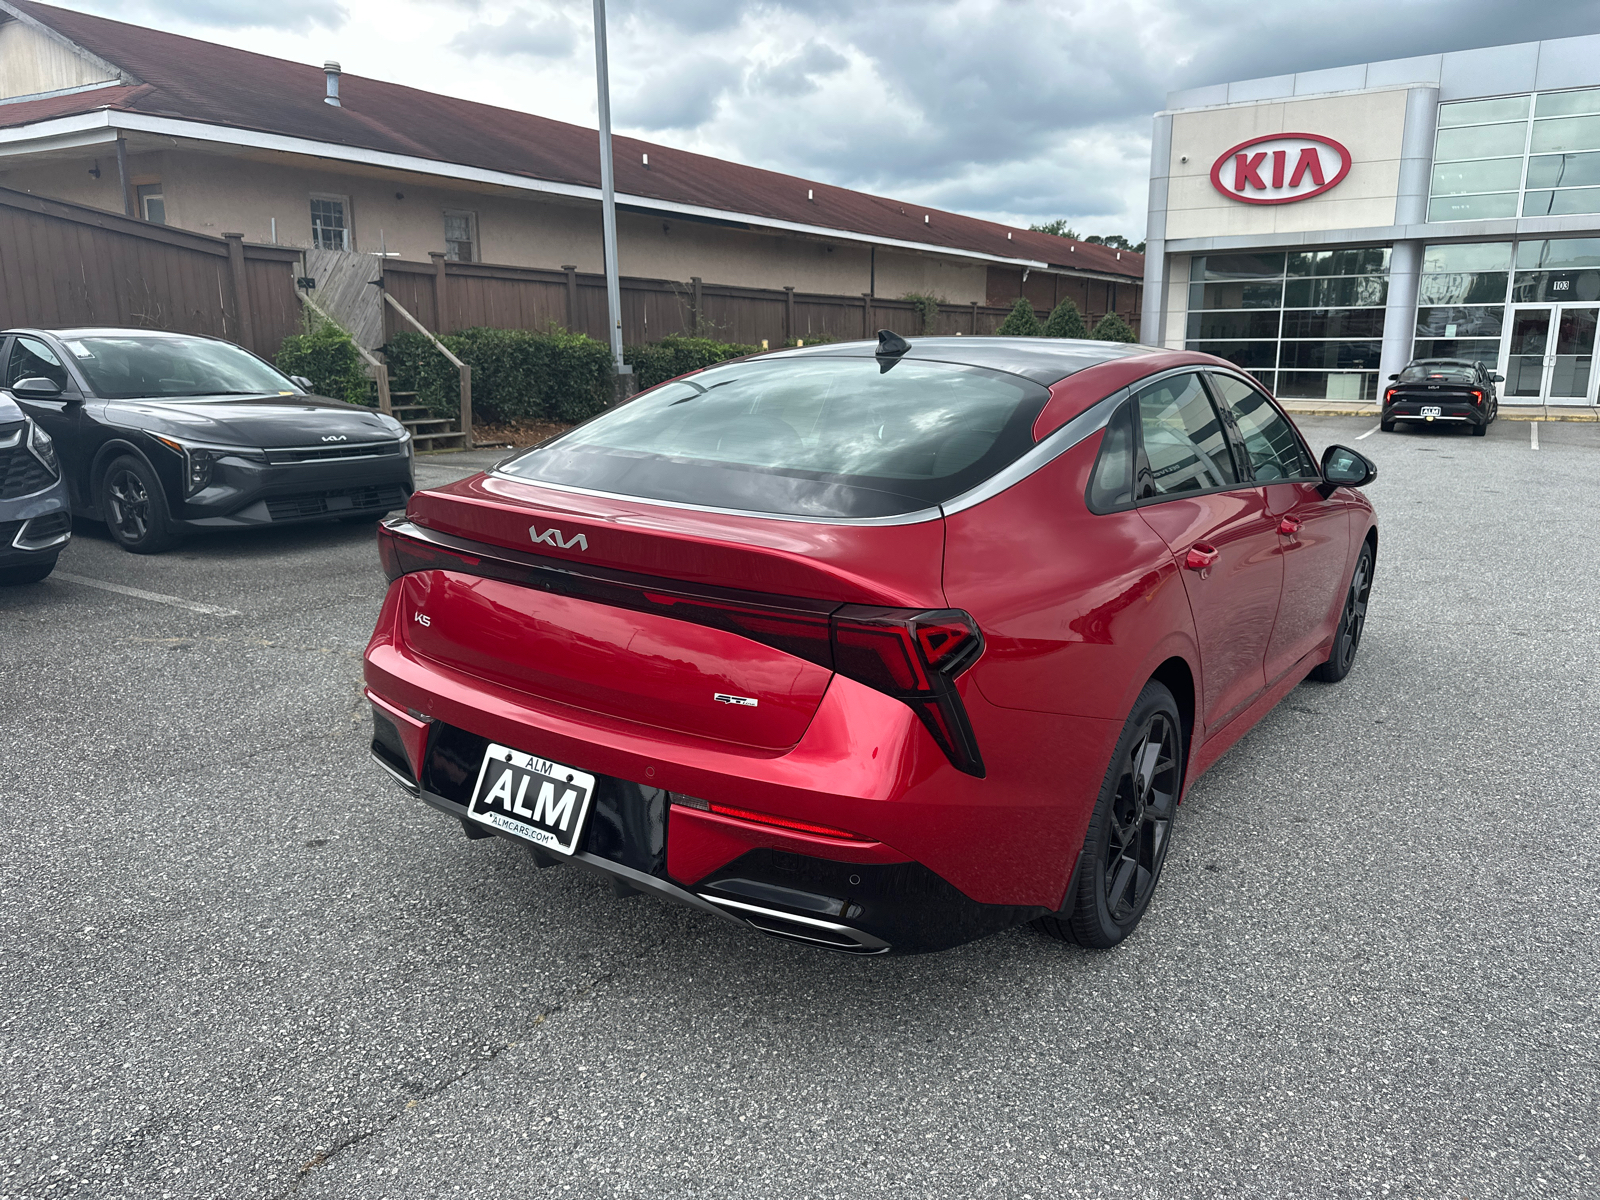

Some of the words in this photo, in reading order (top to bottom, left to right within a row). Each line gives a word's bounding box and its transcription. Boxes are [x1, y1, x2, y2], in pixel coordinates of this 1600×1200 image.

[1234, 147, 1325, 191] KIA
[1554, 281, 1568, 290] 103
[528, 525, 588, 551] KIA
[414, 611, 431, 627] K5
[525, 757, 553, 775] ALM
[483, 768, 578, 832] ALM
[491, 815, 550, 844] ALMCARS.COM
